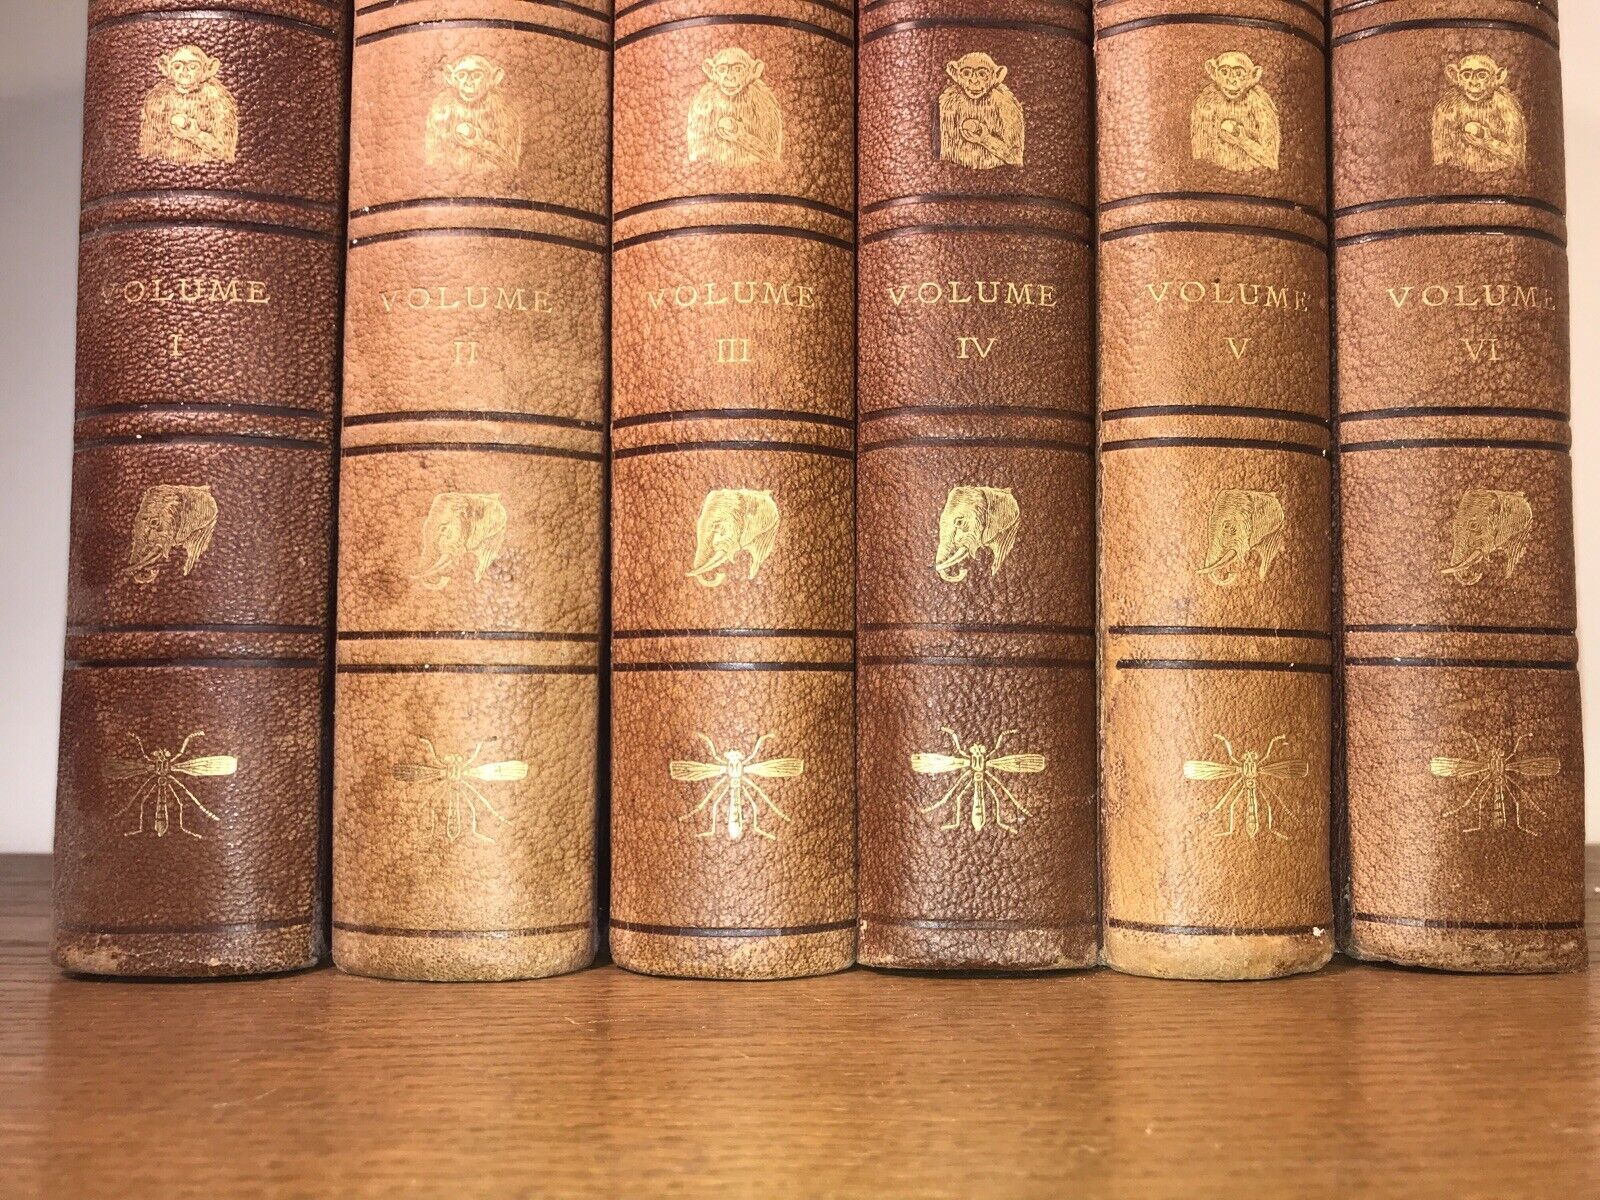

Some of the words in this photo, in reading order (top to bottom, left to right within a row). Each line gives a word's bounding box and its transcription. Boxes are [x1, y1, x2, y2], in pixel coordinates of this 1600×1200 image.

[100, 279, 271, 304] VOLUME
[379, 286, 553, 313] VOLUME
[646, 281, 816, 310] VOLUME
[887, 281, 1057, 307] VOLUME
[1145, 281, 1309, 312] VOLUME
[169, 334, 183, 357] I
[453, 340, 479, 365] II
[716, 338, 752, 363] III
[954, 336, 999, 360] IV
[1223, 337, 1252, 360] V
[1460, 338, 1501, 362] VI
